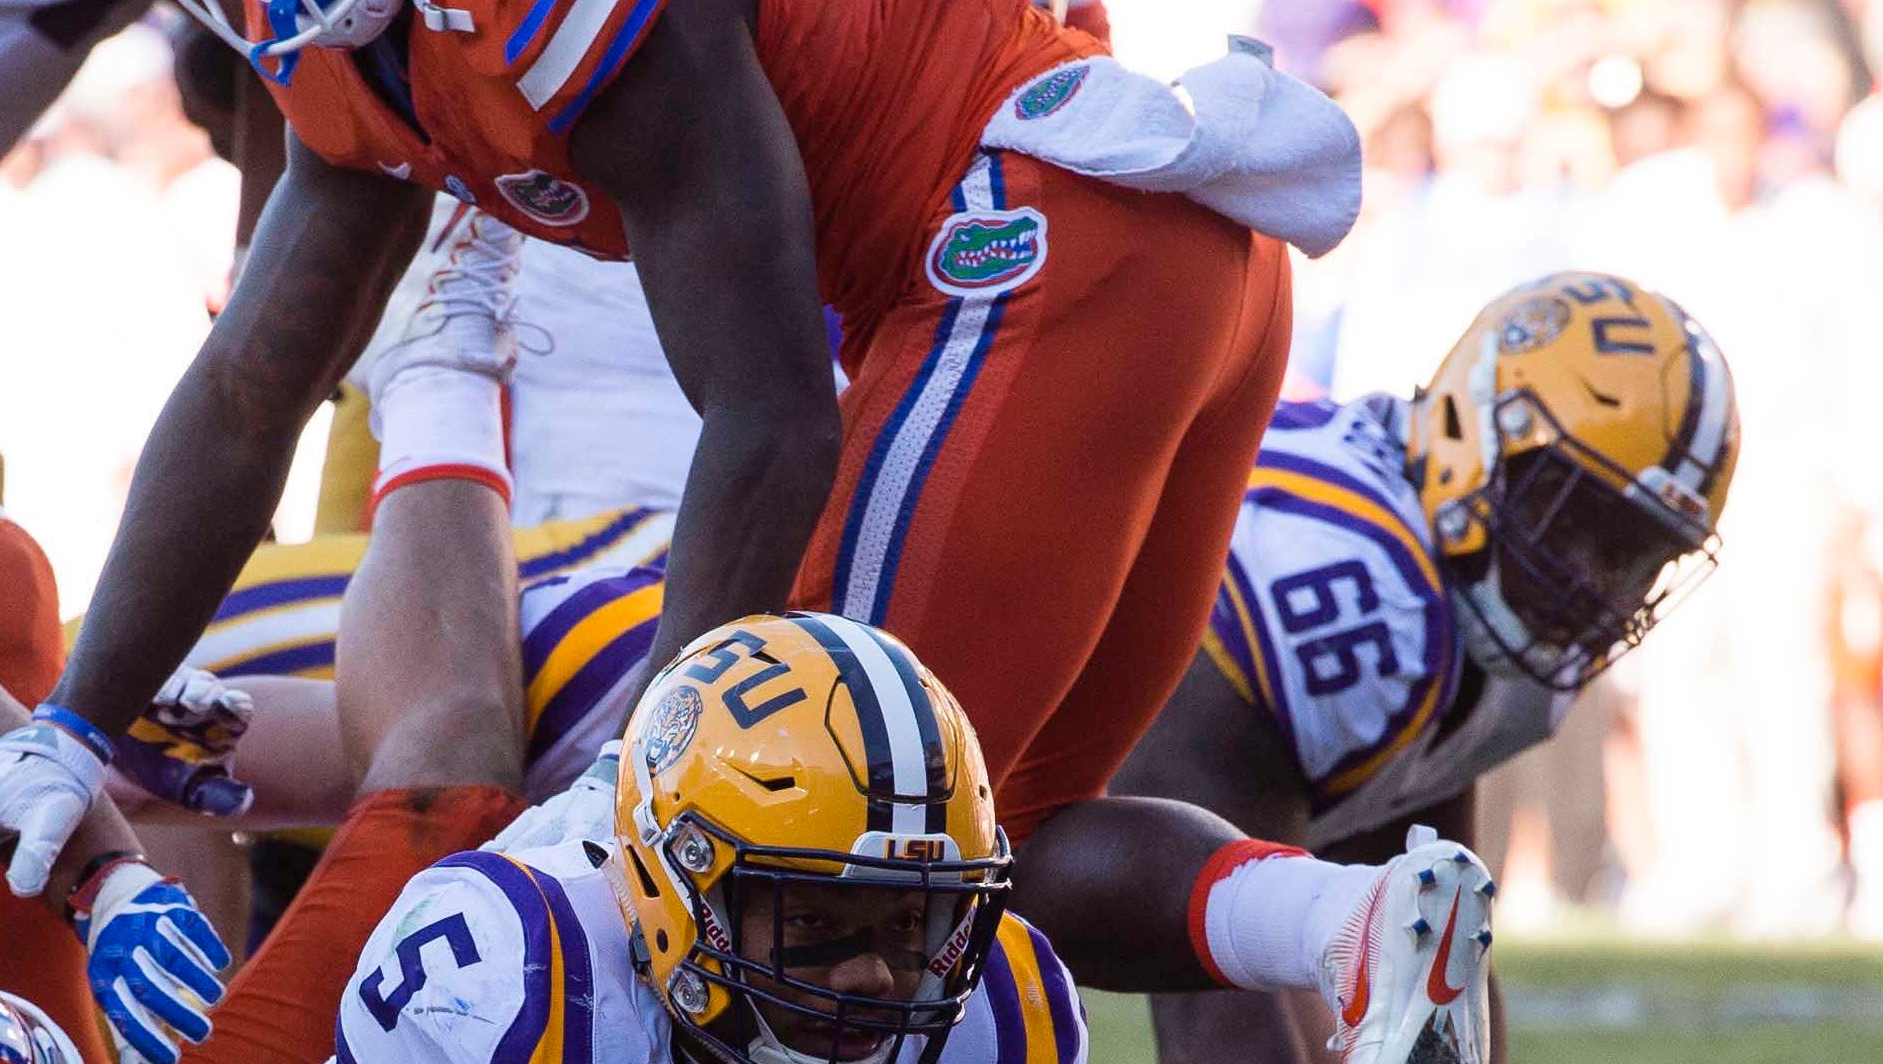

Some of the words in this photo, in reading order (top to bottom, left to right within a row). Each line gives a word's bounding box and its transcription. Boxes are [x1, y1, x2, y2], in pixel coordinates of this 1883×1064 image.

[1562, 277, 1656, 355] SU
[684, 629, 809, 730] SU
[885, 838, 946, 862] LSU
[357, 911, 483, 1034] 5
